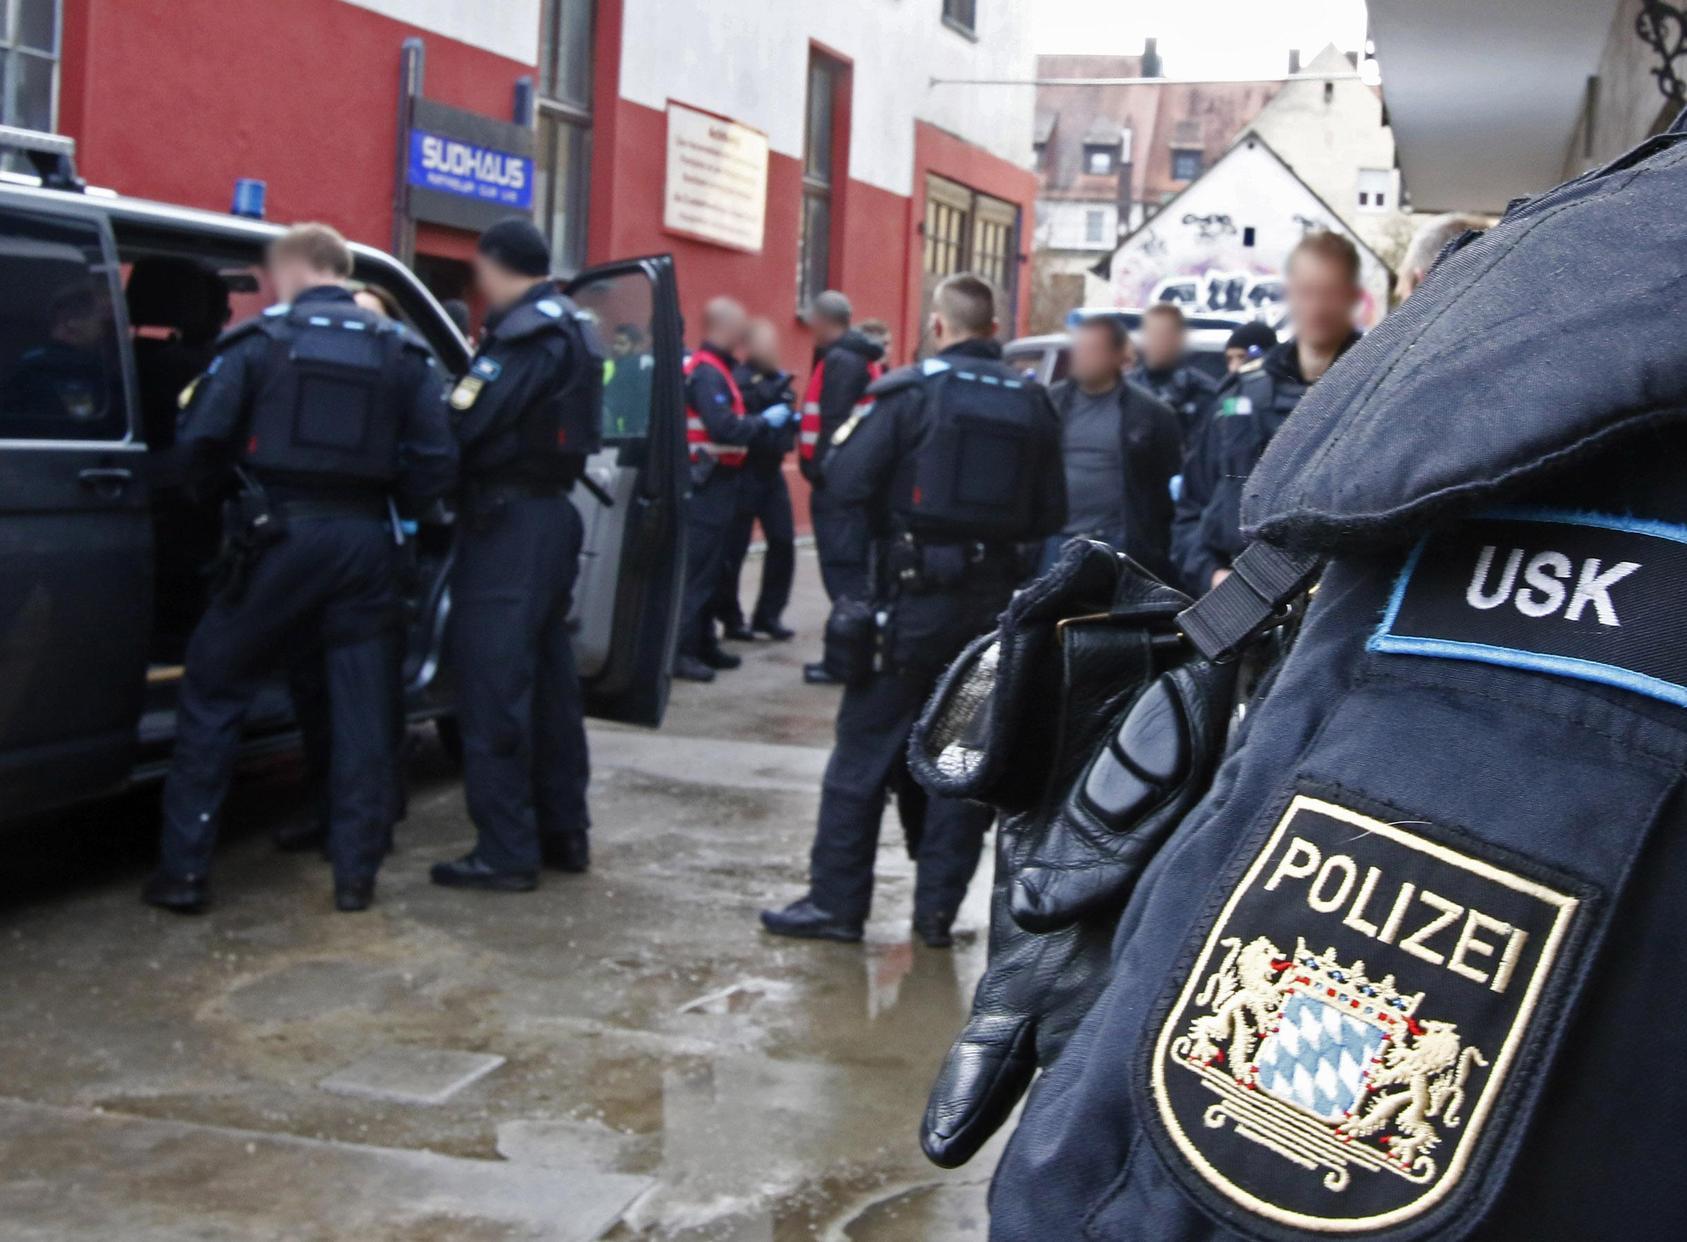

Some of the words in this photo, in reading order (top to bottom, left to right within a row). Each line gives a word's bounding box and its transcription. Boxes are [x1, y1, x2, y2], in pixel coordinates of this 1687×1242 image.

[421, 136, 525, 189] SUDHAUS
[1466, 545, 1642, 627] USK
[1264, 837, 1529, 993] POLIZEI
